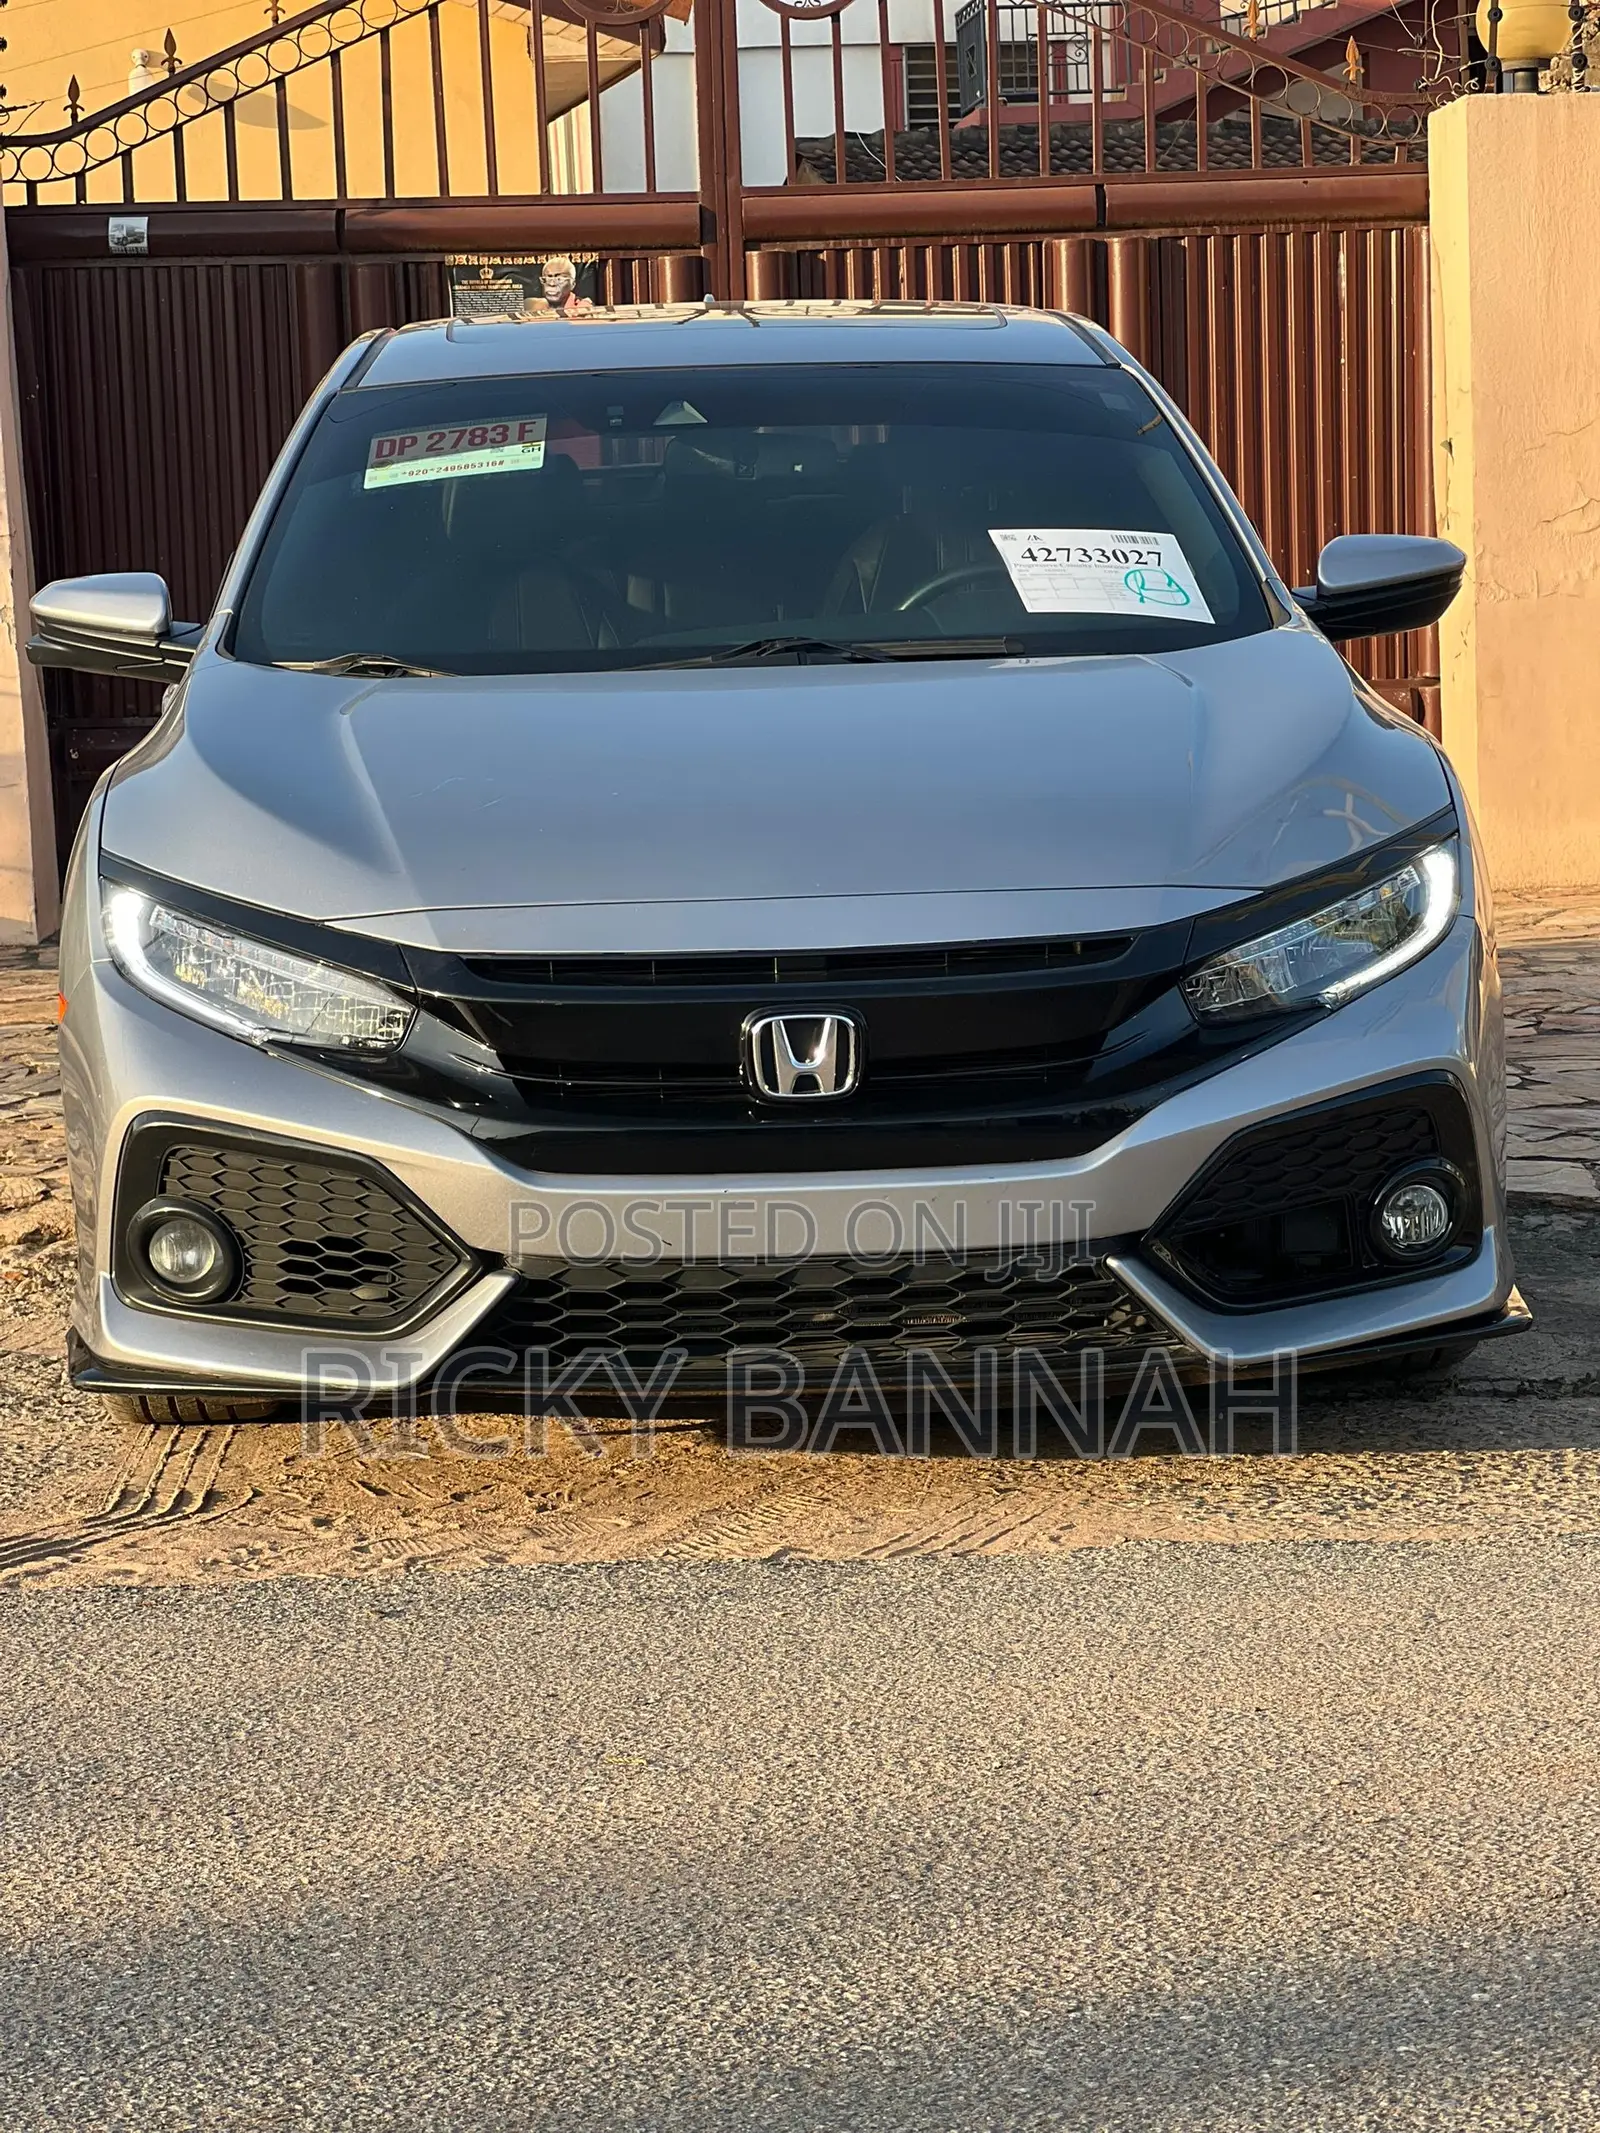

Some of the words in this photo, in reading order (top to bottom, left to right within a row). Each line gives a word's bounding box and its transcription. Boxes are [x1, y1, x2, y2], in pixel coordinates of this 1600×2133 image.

[375, 435, 418, 459] DP
[425, 424, 510, 452] 2783
[517, 421, 537, 442] F
[521, 446, 541, 454] GH
[1021, 547, 1162, 567] 42733027
